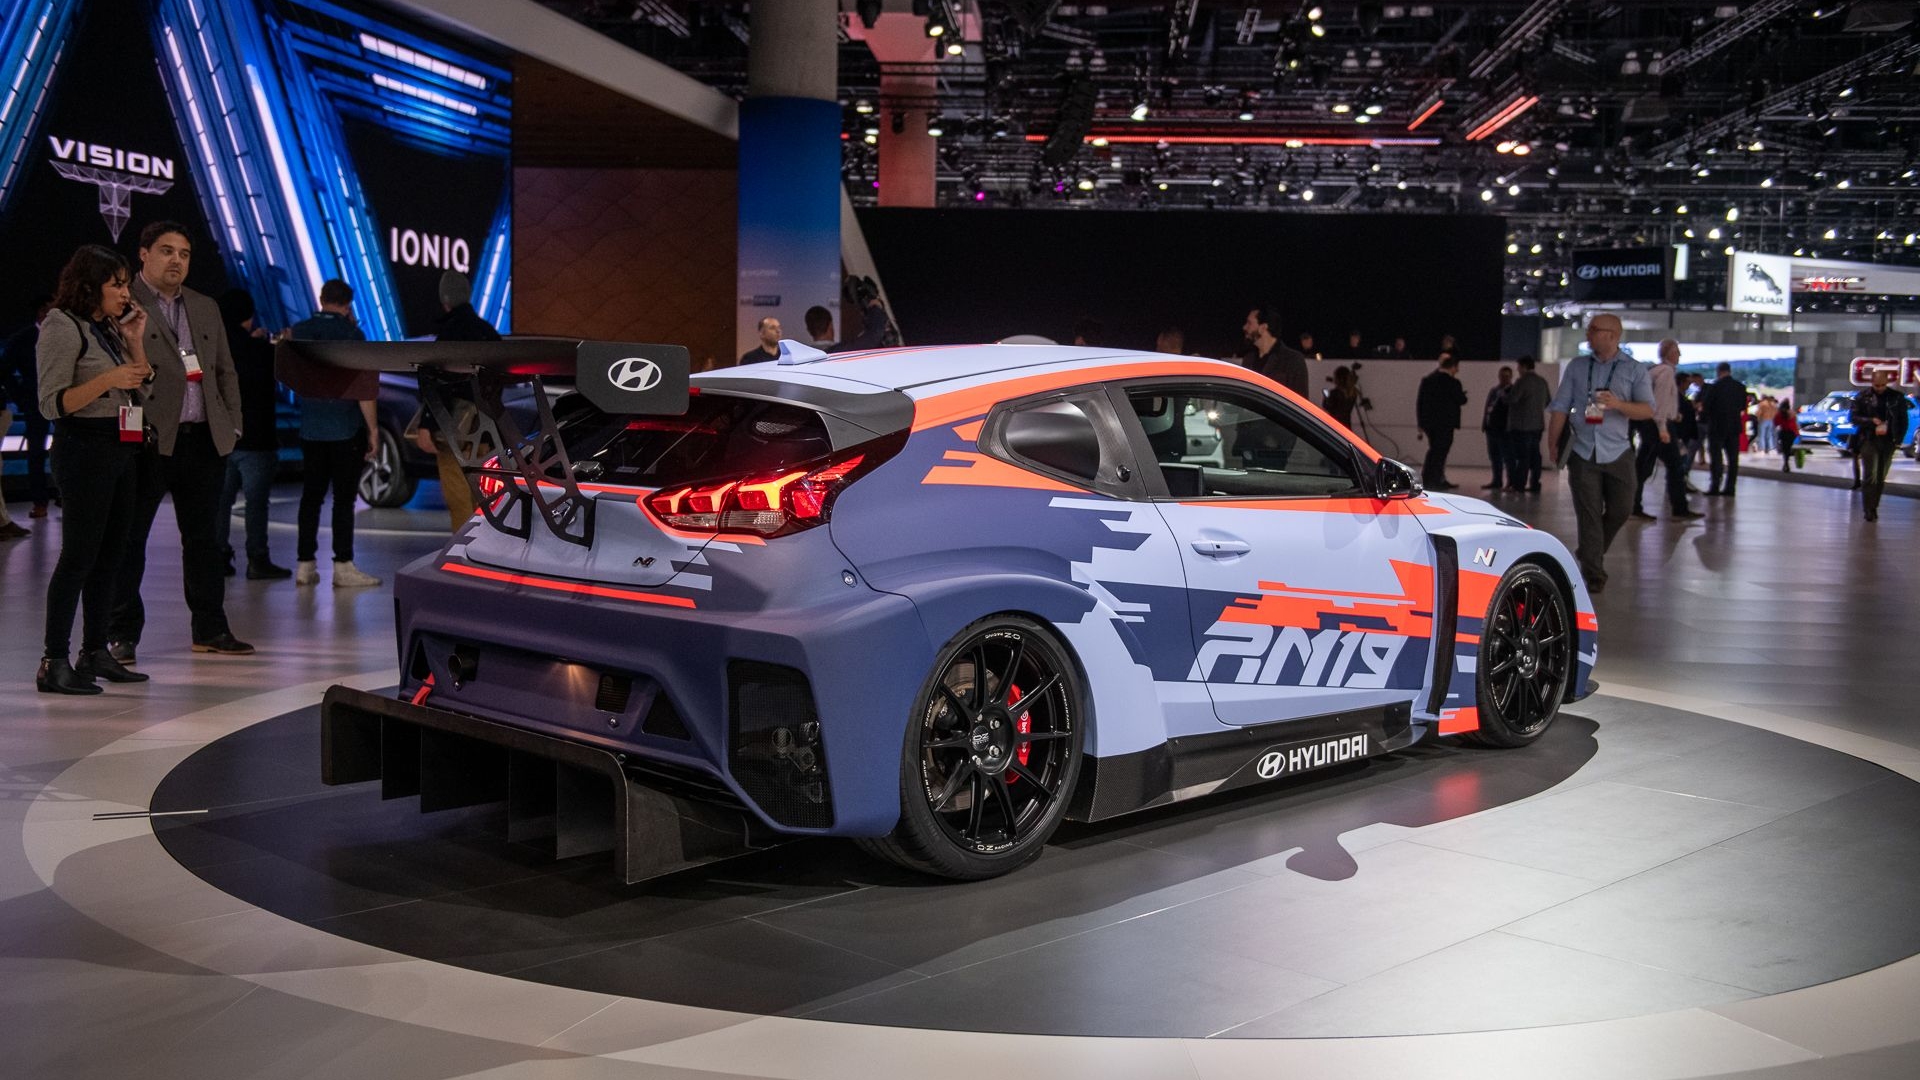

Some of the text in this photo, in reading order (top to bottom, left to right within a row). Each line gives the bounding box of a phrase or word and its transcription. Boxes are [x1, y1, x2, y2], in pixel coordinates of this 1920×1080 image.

[48, 135, 175, 180] VISION
[390, 227, 470, 273] IONIQ
[1601, 263, 1661, 277] HYUNDAI
[1742, 294, 1784, 306] JAGUAR
[1287, 734, 1369, 774] HYUNDAI
